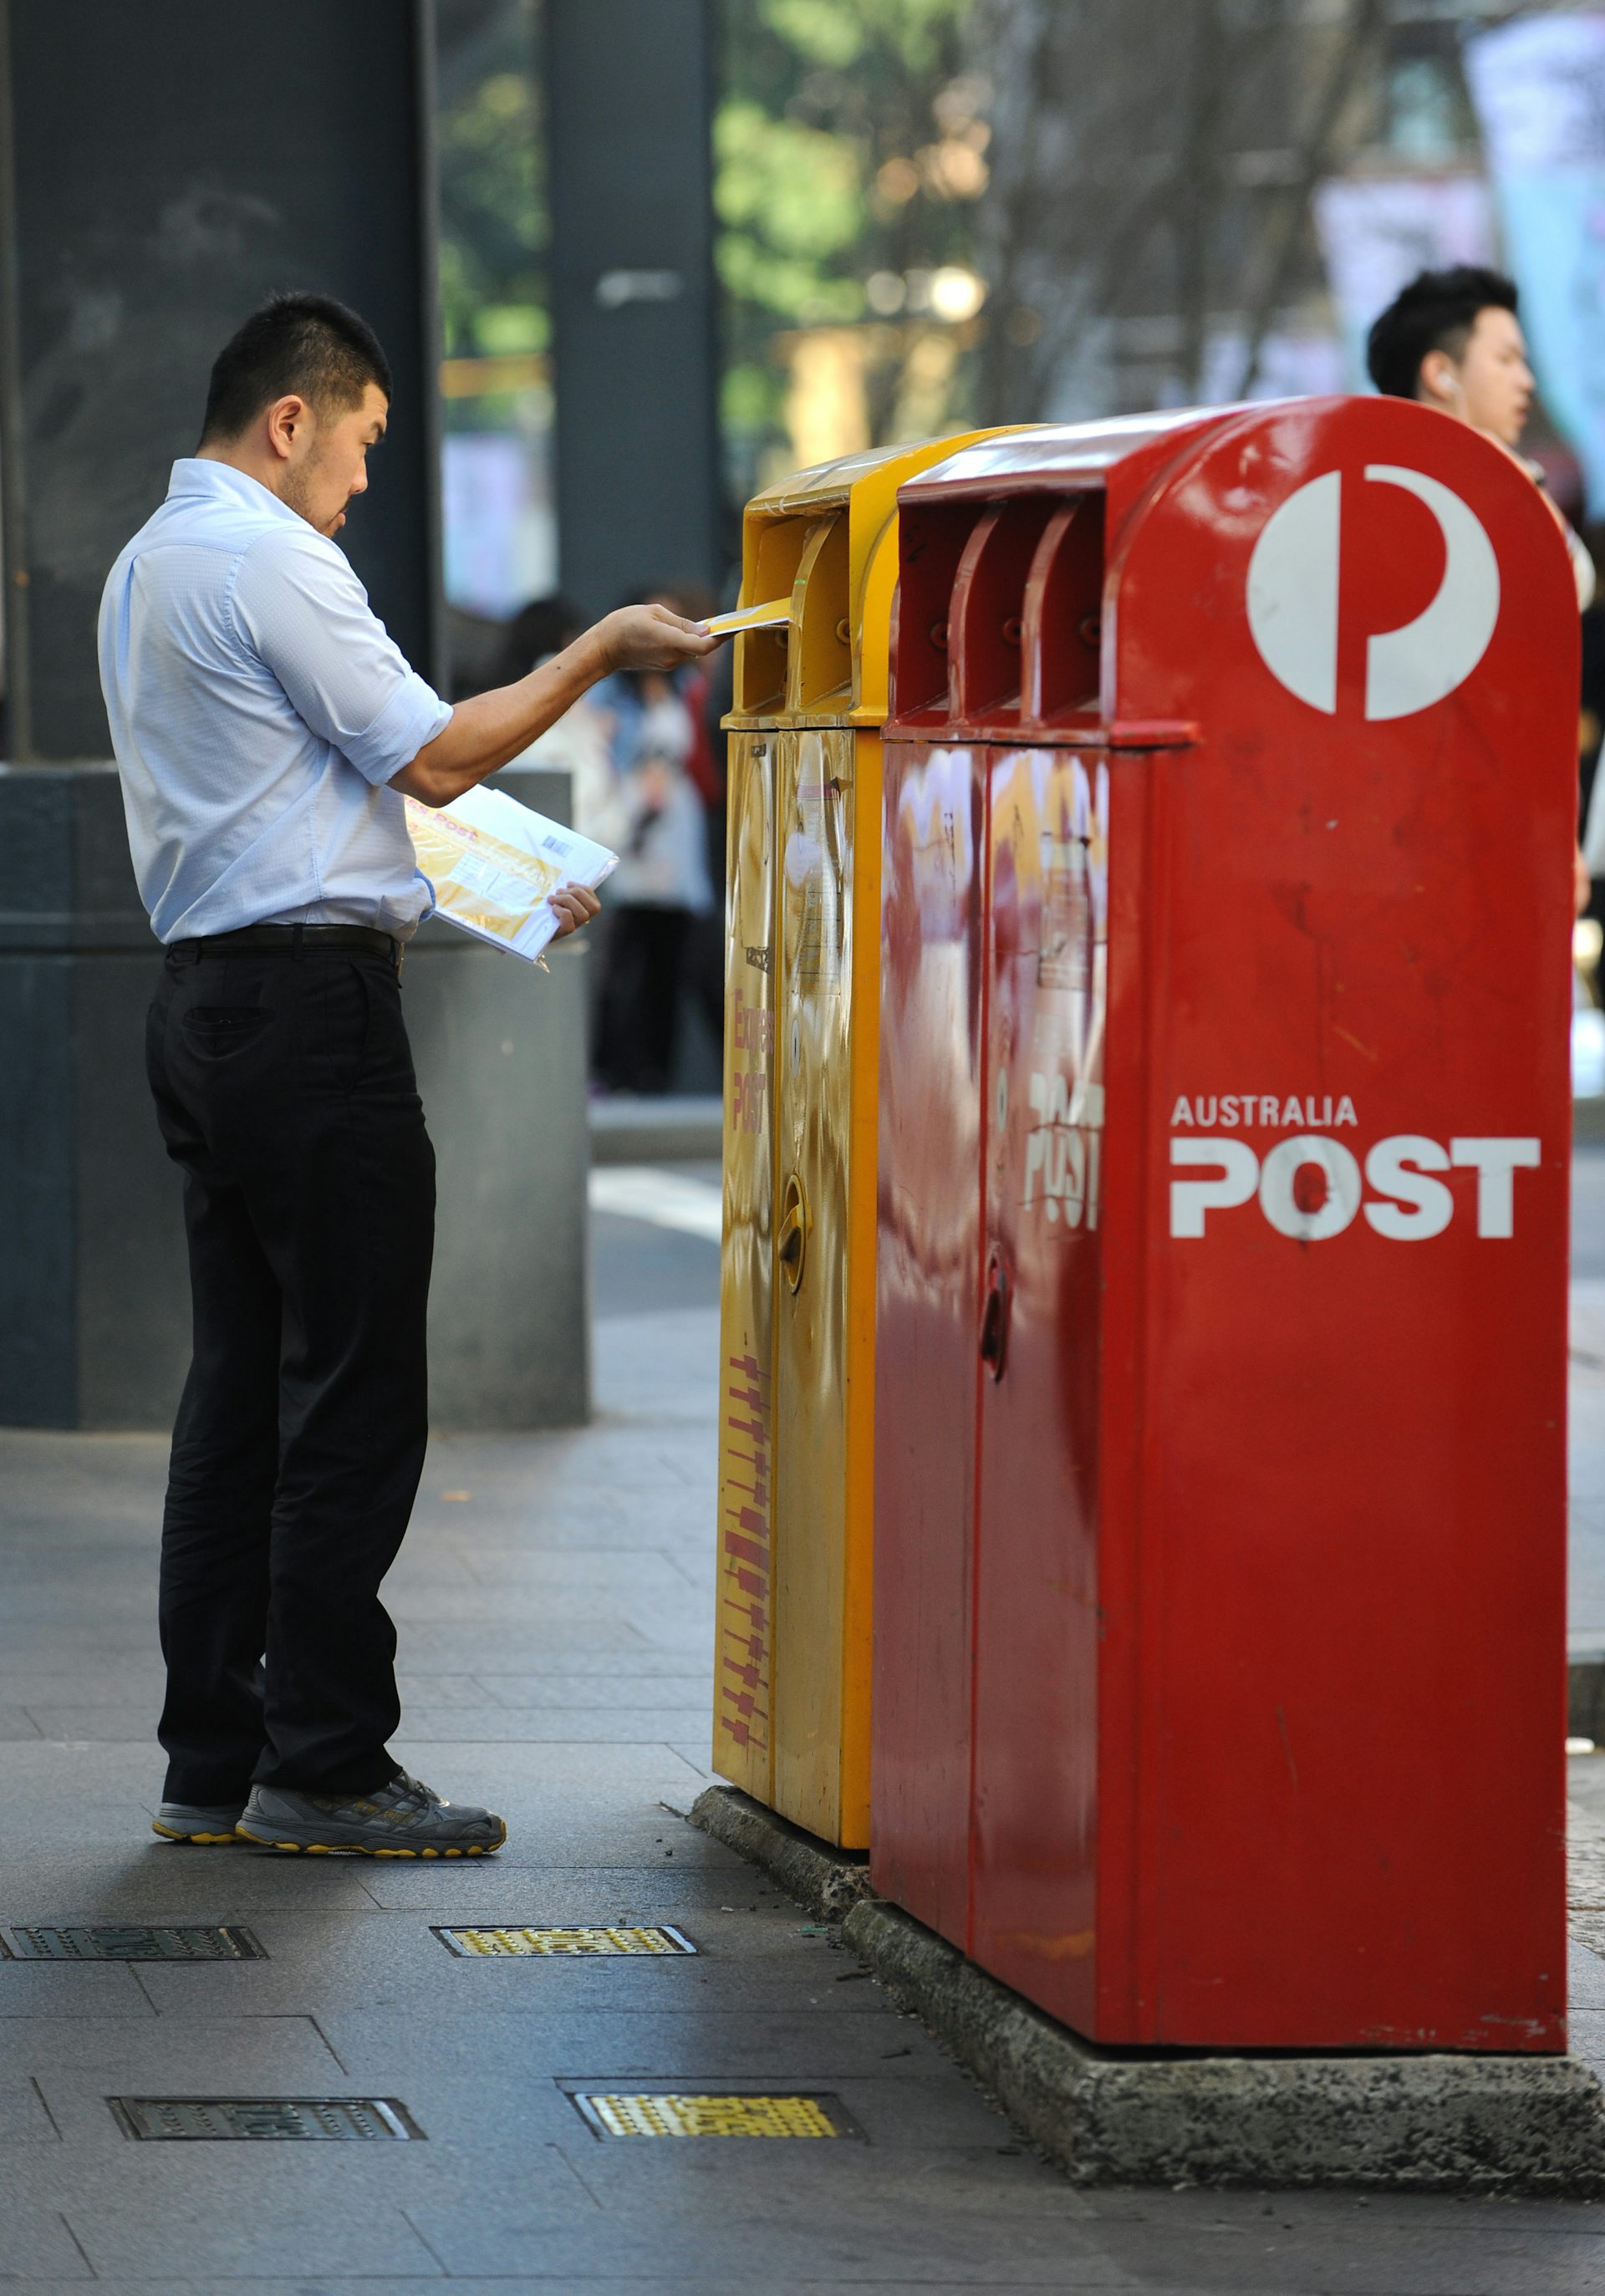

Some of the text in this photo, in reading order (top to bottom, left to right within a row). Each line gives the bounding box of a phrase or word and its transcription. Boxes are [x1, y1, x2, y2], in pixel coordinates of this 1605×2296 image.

[1024, 1072, 1104, 1231] POST
[1171, 1095, 1358, 1127] AUSTRALIA
[1170, 1134, 1541, 1240] POST
